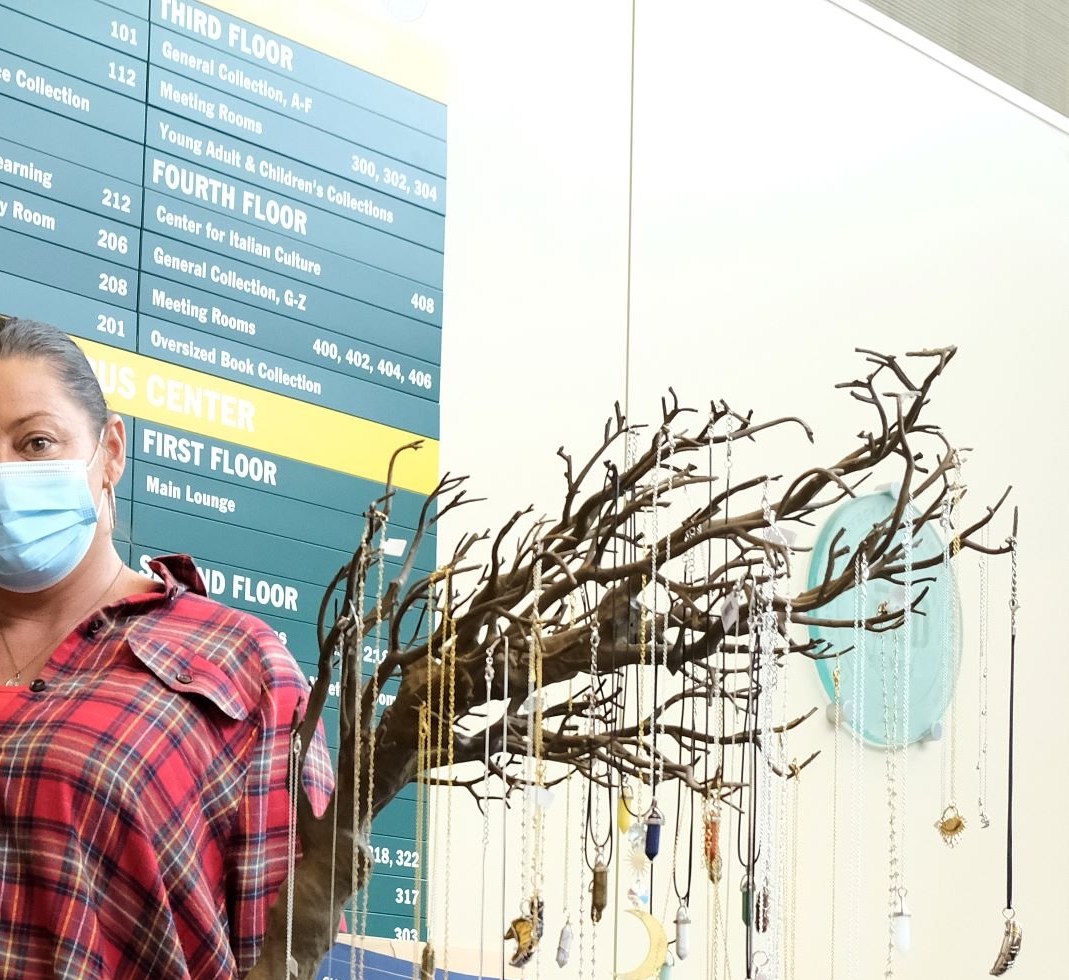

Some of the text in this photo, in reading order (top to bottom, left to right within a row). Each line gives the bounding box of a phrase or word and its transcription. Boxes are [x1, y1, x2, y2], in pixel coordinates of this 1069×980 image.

[110, 20, 138, 46] 101
[161, 0, 293, 72] THIRD FLOOR
[15, 69, 90, 112] Collection
[108, 61, 136, 87] 112
[162, 40, 313, 114] General Collection, A-F
[160, 81, 263, 135] Meeting Rooms
[159, 122, 394, 224] Young Adult & Children's Collections
[351, 154, 437, 202] 300, 302, 304
[12, 201, 55, 231] Room
[101, 188, 131, 214] 212
[152, 159, 308, 236] FOURTH FLOOR
[97, 229, 128, 254] 206
[156, 205, 321, 276] Center for Italian Culture
[98, 273, 128, 297] 208
[153, 246, 307, 311] General Collection, G-Z
[152, 288, 256, 336] Meeting Rooms
[411, 292, 435, 314] 408
[96, 314, 125, 338] 201
[150, 329, 321, 396] Oversized Book Collection
[312, 338, 432, 389] 400, 402, 404, 406
[146, 373, 256, 433] CENTER
[143, 428, 277, 486] FIRST FLOOR
[146, 475, 236, 514] Main Lounge
[232, 574, 298, 612] FLOOR
[396, 849, 419, 868] 322
[395, 888, 419, 905] 317
[394, 927, 418, 941] 303
